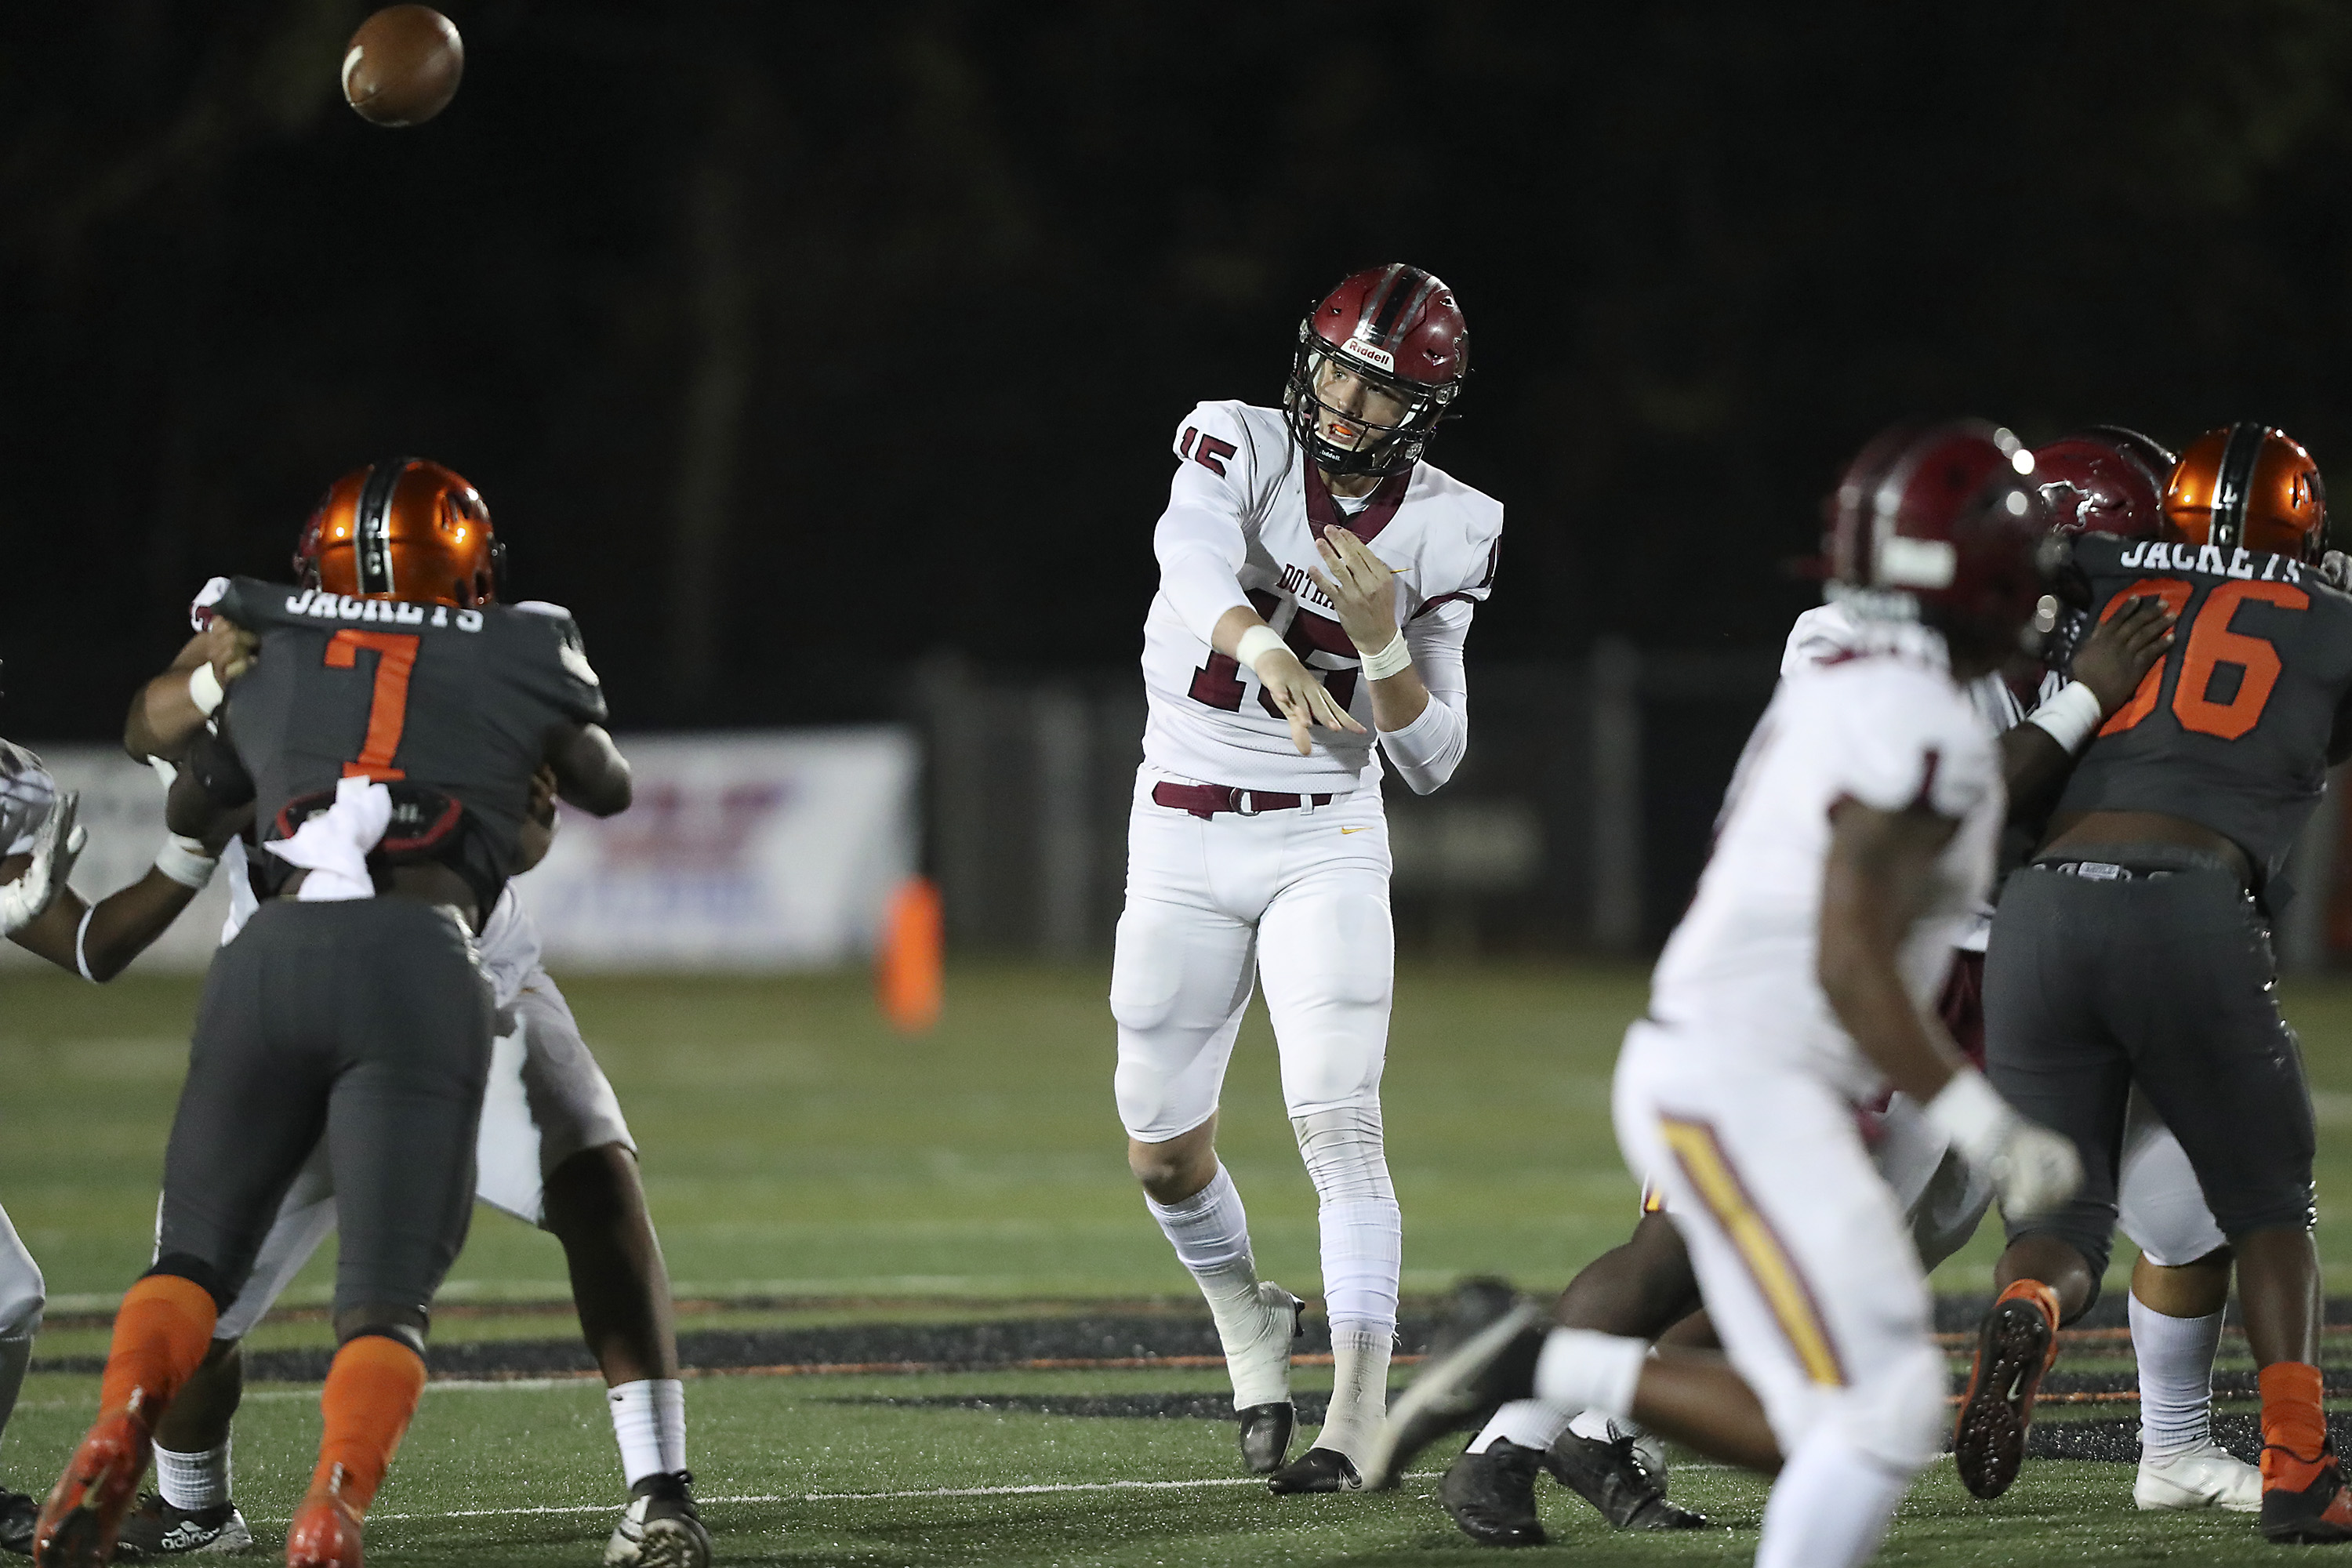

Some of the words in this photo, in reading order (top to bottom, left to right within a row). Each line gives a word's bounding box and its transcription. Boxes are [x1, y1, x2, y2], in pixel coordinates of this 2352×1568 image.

[1349, 340, 1390, 365] Riddell
[1180, 426, 1238, 479] 15
[2120, 540, 2306, 584] JACKETS
[324, 628, 420, 782] 7
